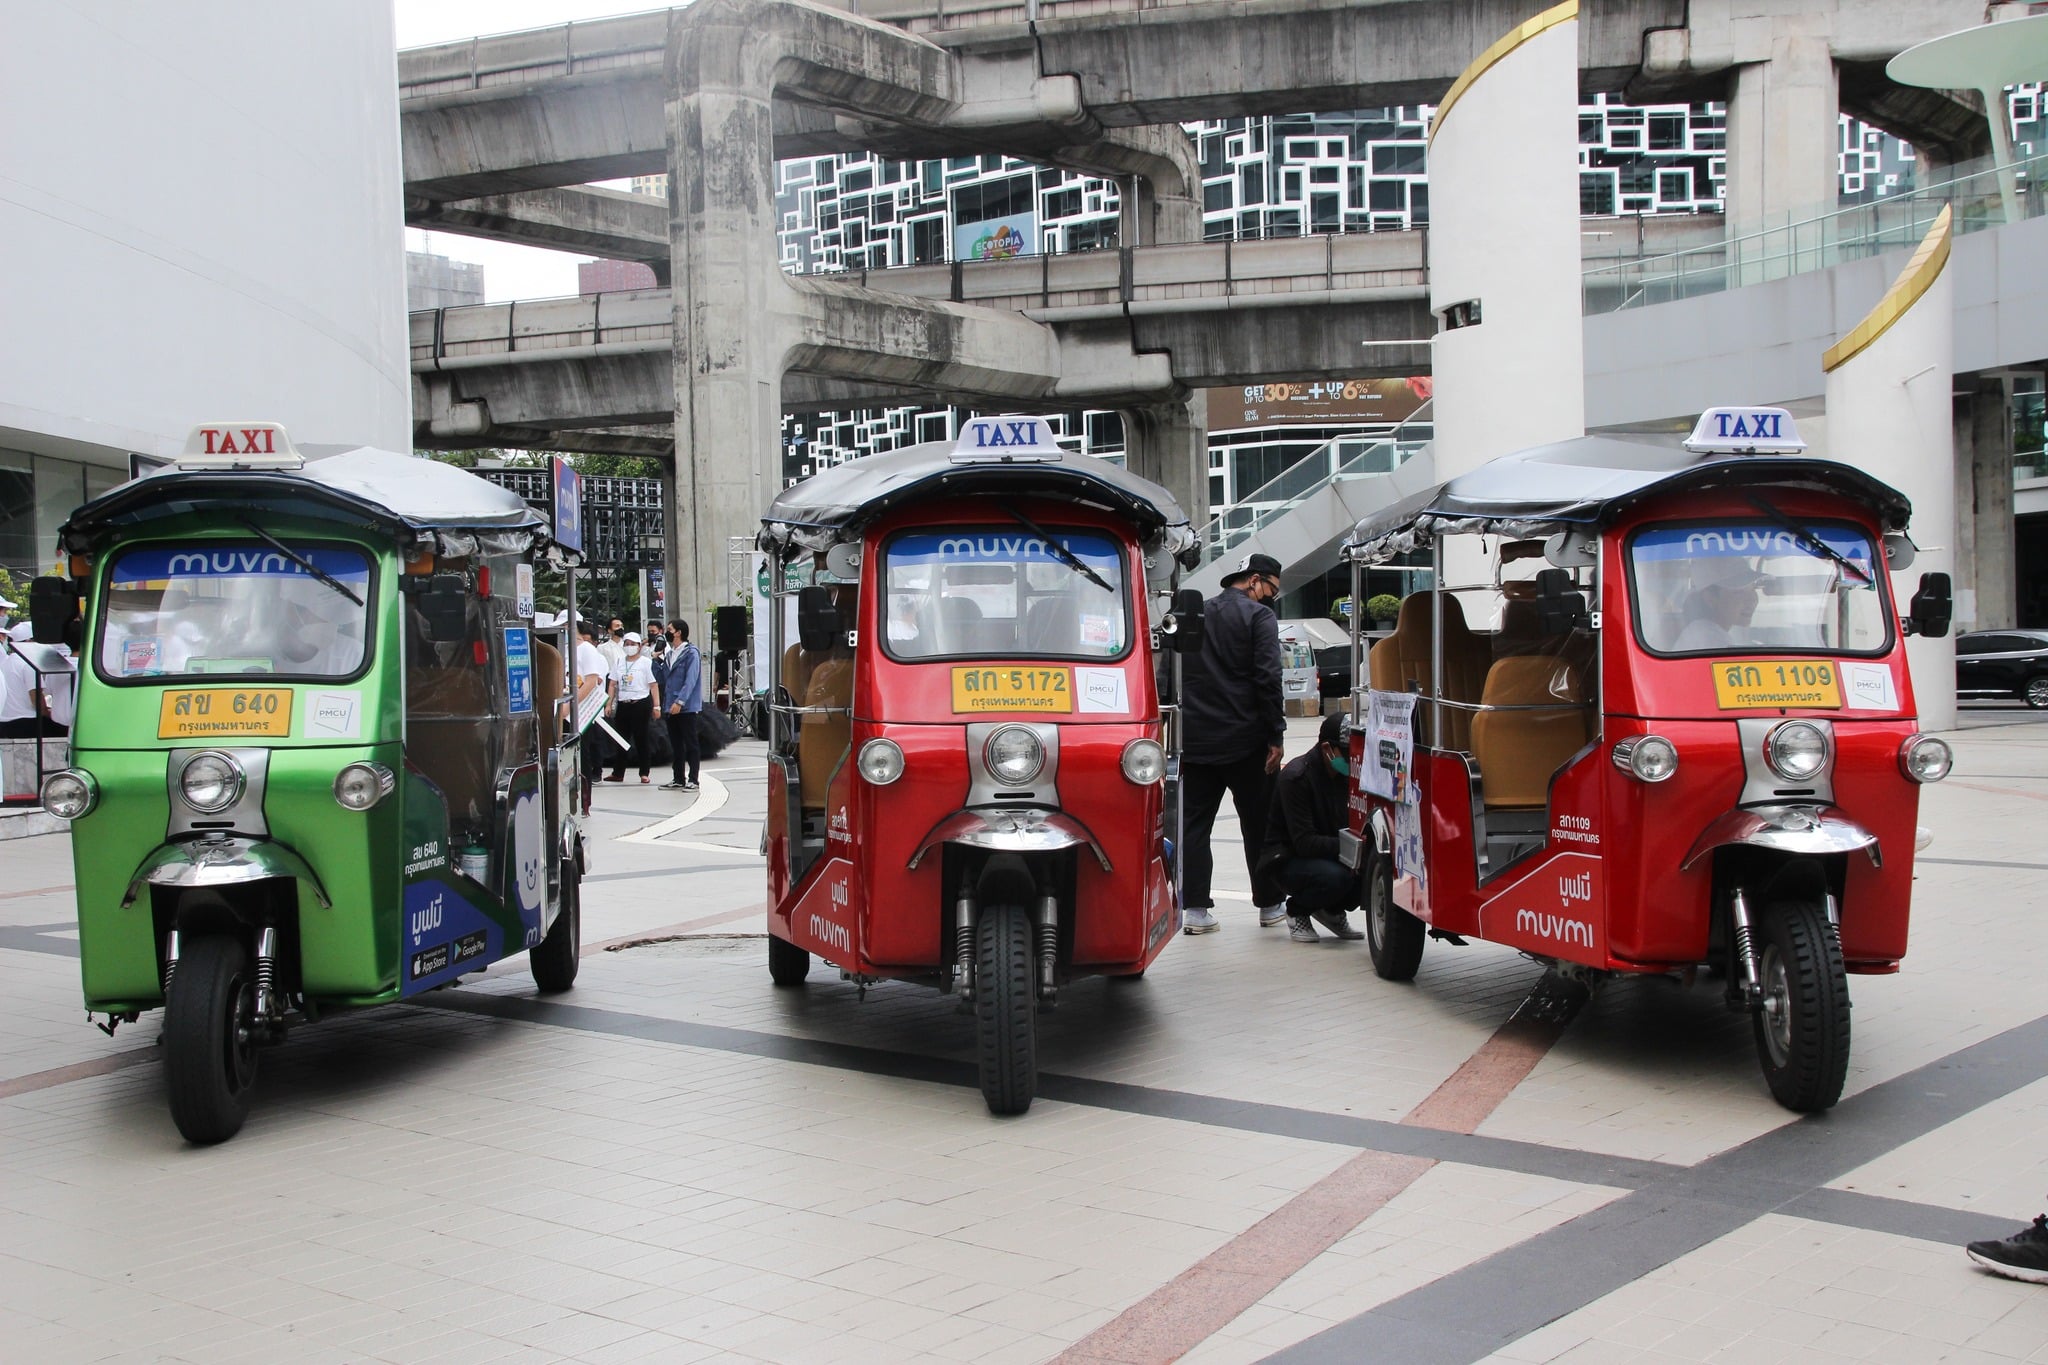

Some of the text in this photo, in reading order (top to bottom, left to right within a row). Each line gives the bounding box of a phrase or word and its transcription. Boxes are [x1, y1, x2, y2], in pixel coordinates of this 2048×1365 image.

[976, 235, 1020, 251] ECOTOPIA
[1244, 385, 1264, 397] GET
[1326, 382, 1344, 393] UP
[1330, 392, 1341, 400] TO
[1244, 396, 1253, 405] UP
[1255, 395, 1264, 403] TO
[1714, 413, 1782, 438] TAXI
[200, 429, 276, 454] TAXI
[972, 422, 1039, 447] TAXI
[519, 602, 533, 616] 640
[964, 670, 1066, 692] สก 5172
[1726, 665, 1832, 687] สก 1109
[1089, 685, 1114, 693] PMCU
[1856, 681, 1881, 690] PMCU
[174, 693, 278, 716] สข 640
[971, 696, 1054, 710] กรุงเทพมหานคร
[1736, 691, 1822, 706] กรุงเทพมหานคร
[319, 709, 347, 718] PMCU
[178, 720, 270, 735] กรุงเทพมหานคร
[424, 840, 438, 857] 640
[831, 877, 848, 913] มูฟมี
[1559, 871, 1591, 907] มูฟมี
[412, 893, 443, 946] มูฟมี
[463, 944, 477, 956] Google
[422, 956, 446, 974] App Store
